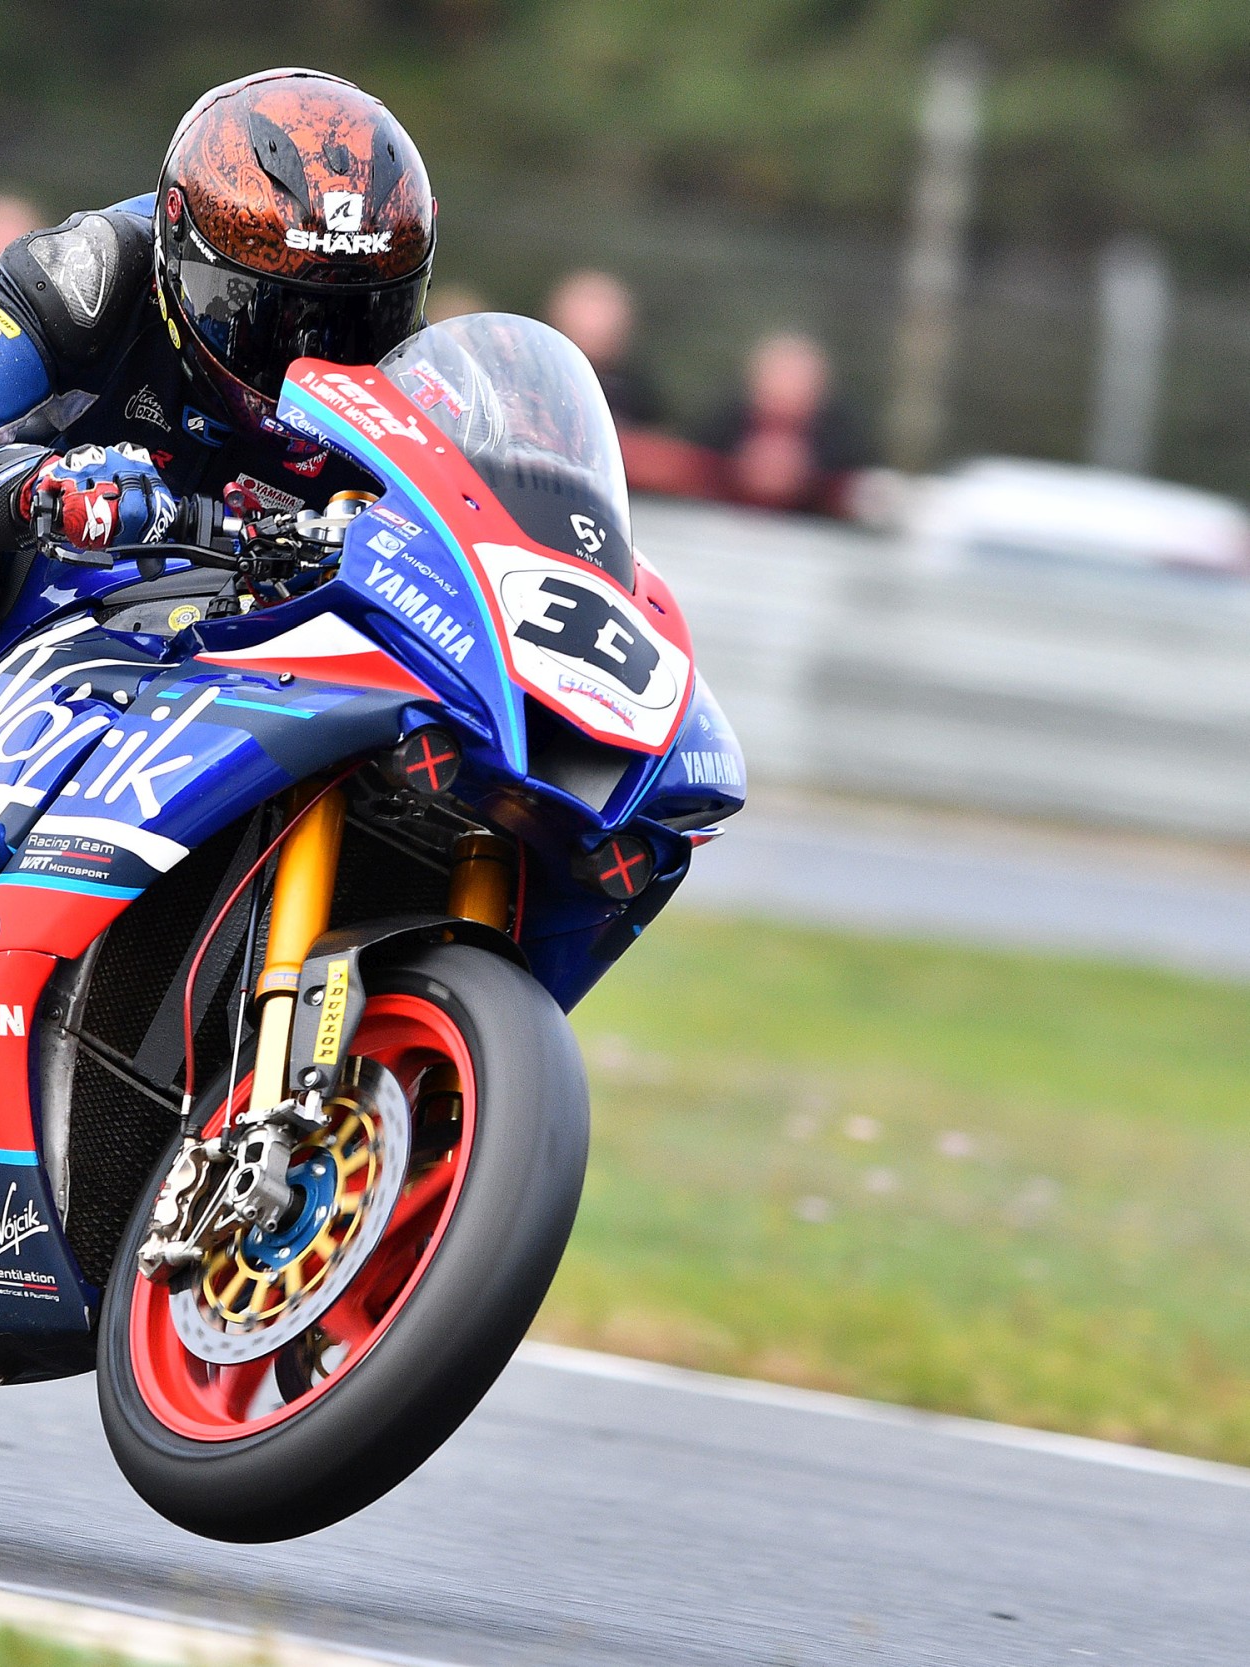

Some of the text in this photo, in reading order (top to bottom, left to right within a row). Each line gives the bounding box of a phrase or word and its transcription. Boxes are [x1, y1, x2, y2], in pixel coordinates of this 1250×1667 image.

[189, 230, 217, 264] SHARK
[285, 228, 392, 255] SHARK
[308, 378, 387, 441] LIBERTY MOTORS
[255, 482, 297, 508] YAMAHA
[364, 559, 476, 664] YAMAHA
[680, 751, 742, 787] YAMAHA
[27, 834, 115, 855] Racing Team
[19, 856, 110, 880] WRT MOTOSPORT
[318, 986, 344, 1059] DUNLOP
